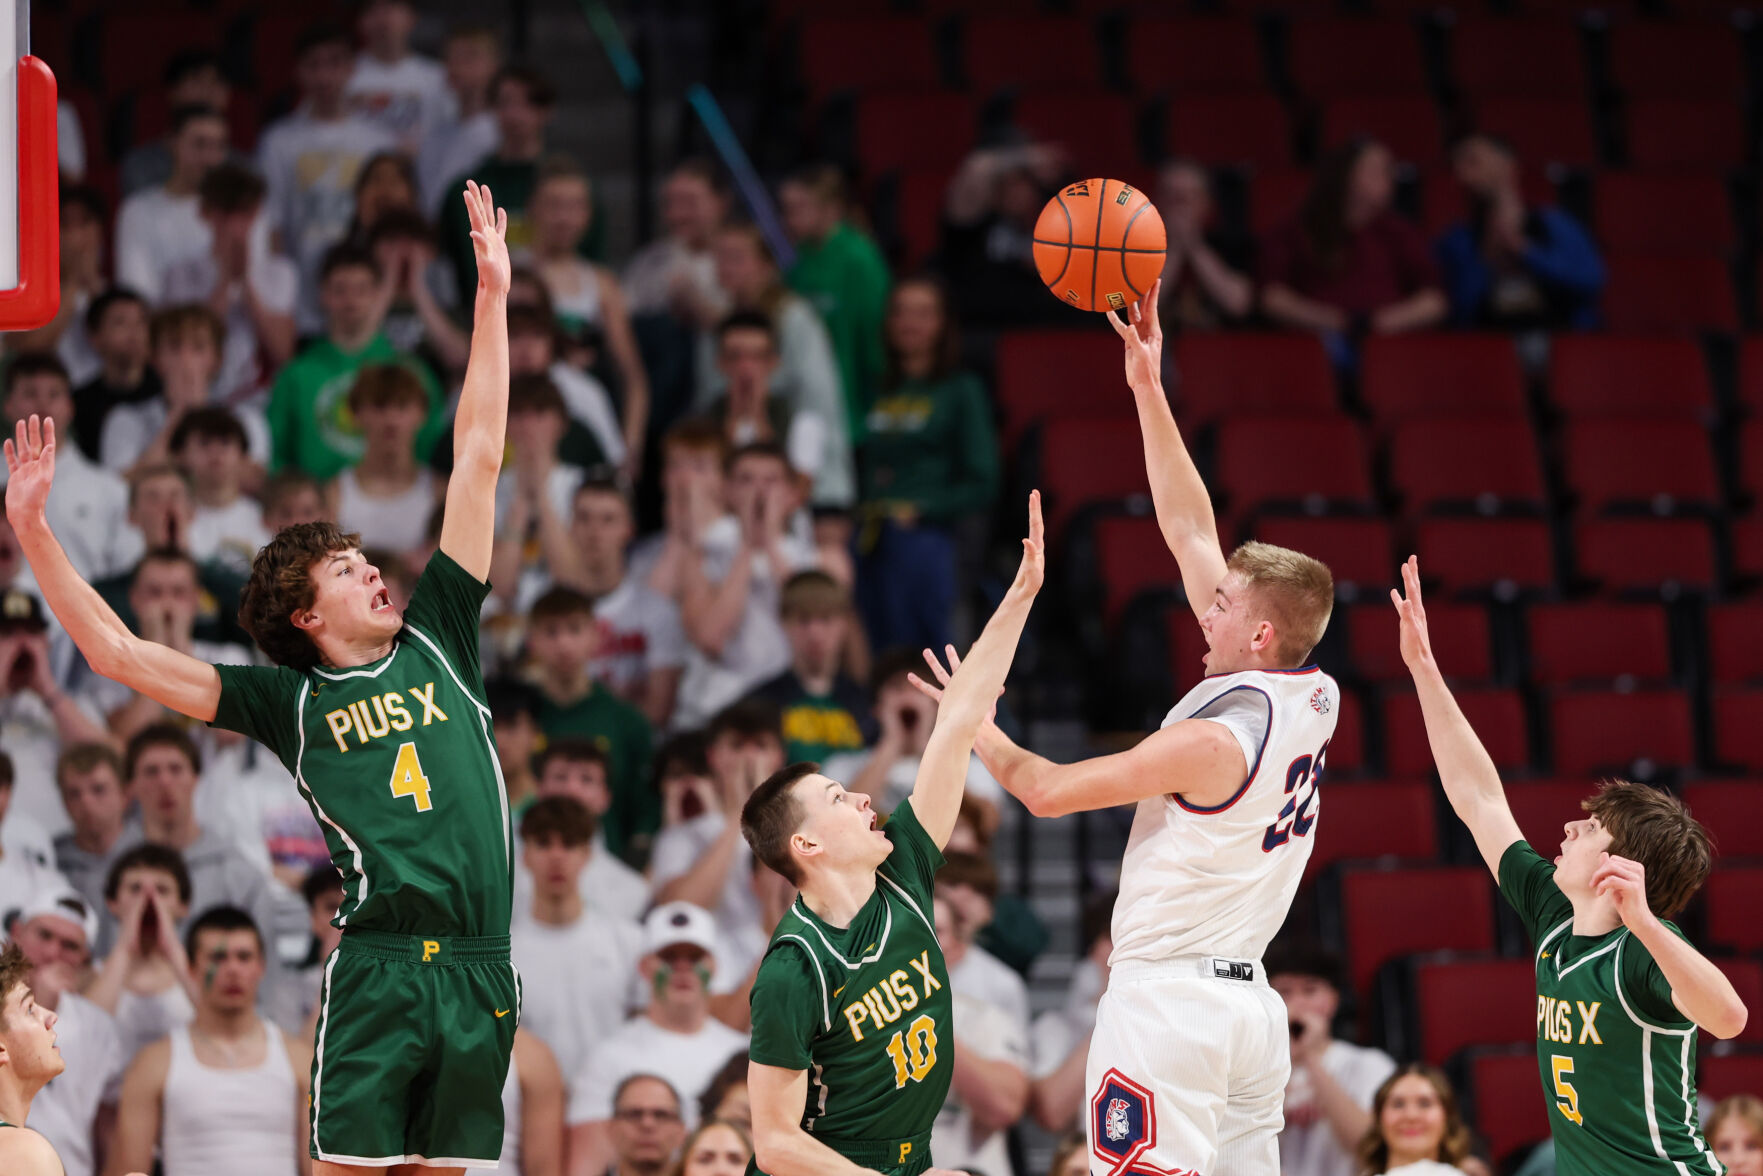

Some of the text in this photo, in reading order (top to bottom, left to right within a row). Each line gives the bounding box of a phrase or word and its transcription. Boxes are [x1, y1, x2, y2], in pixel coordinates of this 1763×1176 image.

[325, 682, 449, 753] PIUS X
[389, 741, 433, 813] 4
[1262, 737, 1330, 853] 22
[422, 940, 440, 962] P
[843, 949, 942, 1042] PIUS X
[1537, 994, 1604, 1045] PIUS X
[886, 1014, 938, 1090] 10
[1551, 1054, 1583, 1127] 5
[898, 1142, 912, 1164] P
